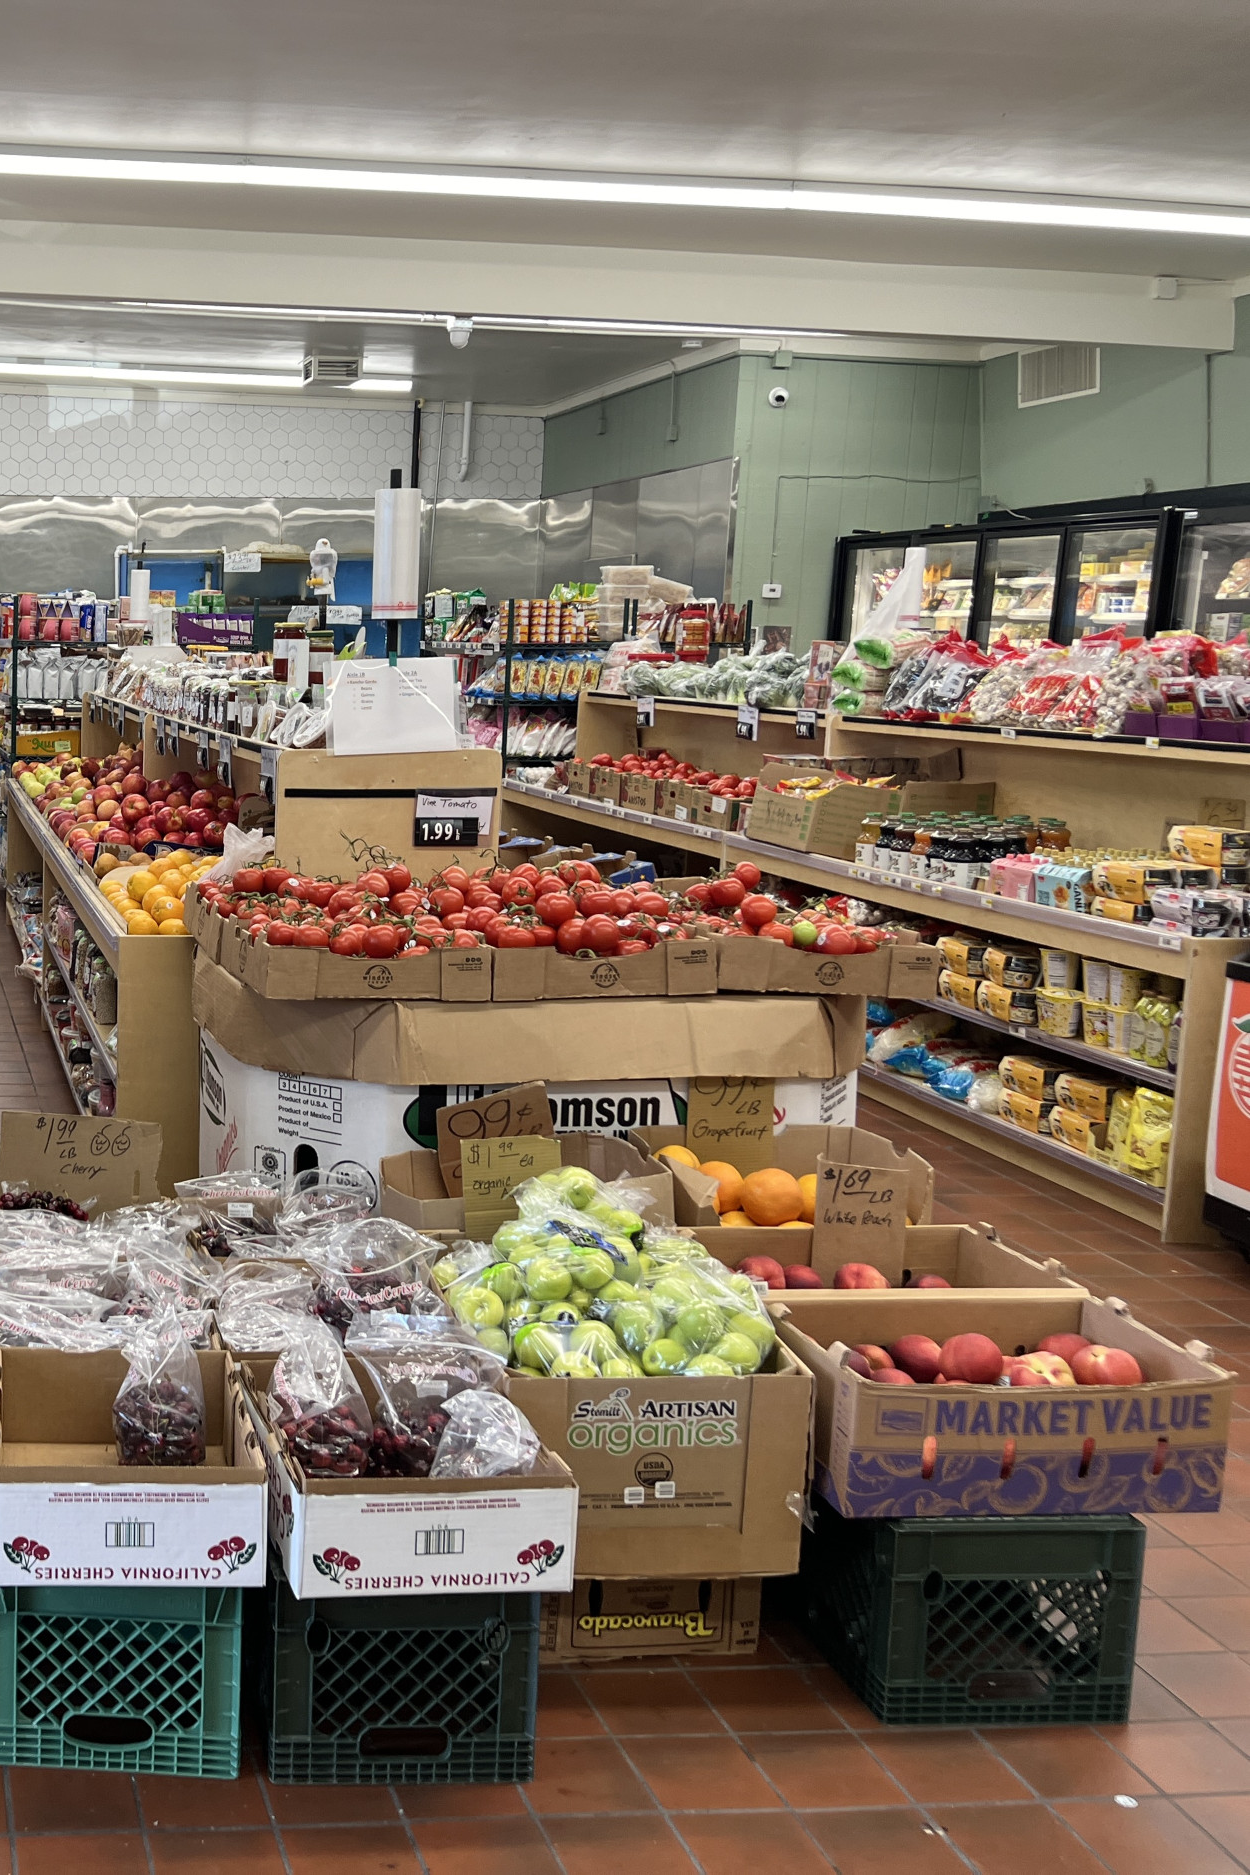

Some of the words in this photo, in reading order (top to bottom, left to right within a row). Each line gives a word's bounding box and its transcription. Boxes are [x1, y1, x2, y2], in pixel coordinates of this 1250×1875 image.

[440, 798, 478, 810] Tomato
[422, 822, 453, 841] 1.99
[278, 1093, 302, 1105] Product
[310, 1099, 329, 1109] U.S.A.
[735, 1100, 762, 1115] LB
[278, 1105, 302, 1116] Product
[302, 1109, 309, 1117] of
[310, 1110, 332, 1121] Mexico
[278, 1116, 302, 1127] Product
[302, 1120, 309, 1128] of
[692, 1118, 771, 1142] Grapefruit
[278, 1126, 299, 1137] Weight
[59, 1147, 77, 1159] LB
[60, 1163, 107, 1180] Cherry
[472, 1176, 511, 1196] organic
[869, 1188, 894, 1204] LB
[823, 1209, 857, 1225] White
[862, 1210, 893, 1227] Peach
[573, 1401, 622, 1420] Stemilt
[640, 1400, 736, 1418] ARTISAN
[935, 1399, 1095, 1436] MARKET
[1100, 1394, 1213, 1434] VALUE
[568, 1420, 736, 1455] organics
[643, 1461, 665, 1470] USDA
[34, 1566, 114, 1580] CHERRIES
[122, 1566, 222, 1580] CALIFORNIA
[430, 1571, 531, 1587] CALIFORNIA
[344, 1574, 425, 1590] CHERRIES
[578, 1611, 716, 1637] Bravocado
